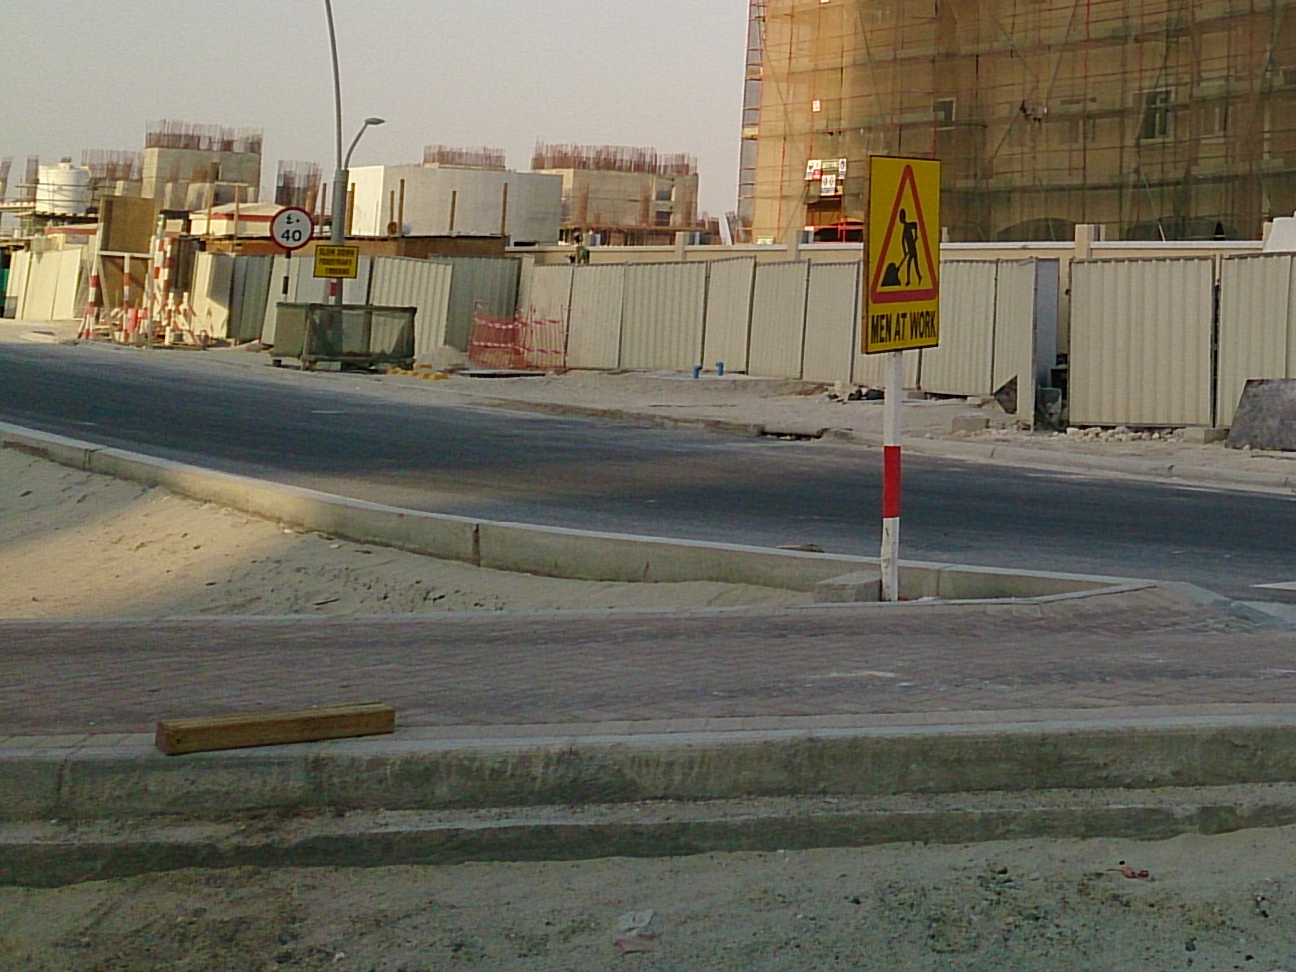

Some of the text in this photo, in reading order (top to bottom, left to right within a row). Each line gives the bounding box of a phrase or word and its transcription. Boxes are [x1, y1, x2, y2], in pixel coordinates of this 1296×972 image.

[281, 229, 302, 242] 40
[871, 310, 936, 344] MEN AT WORK
